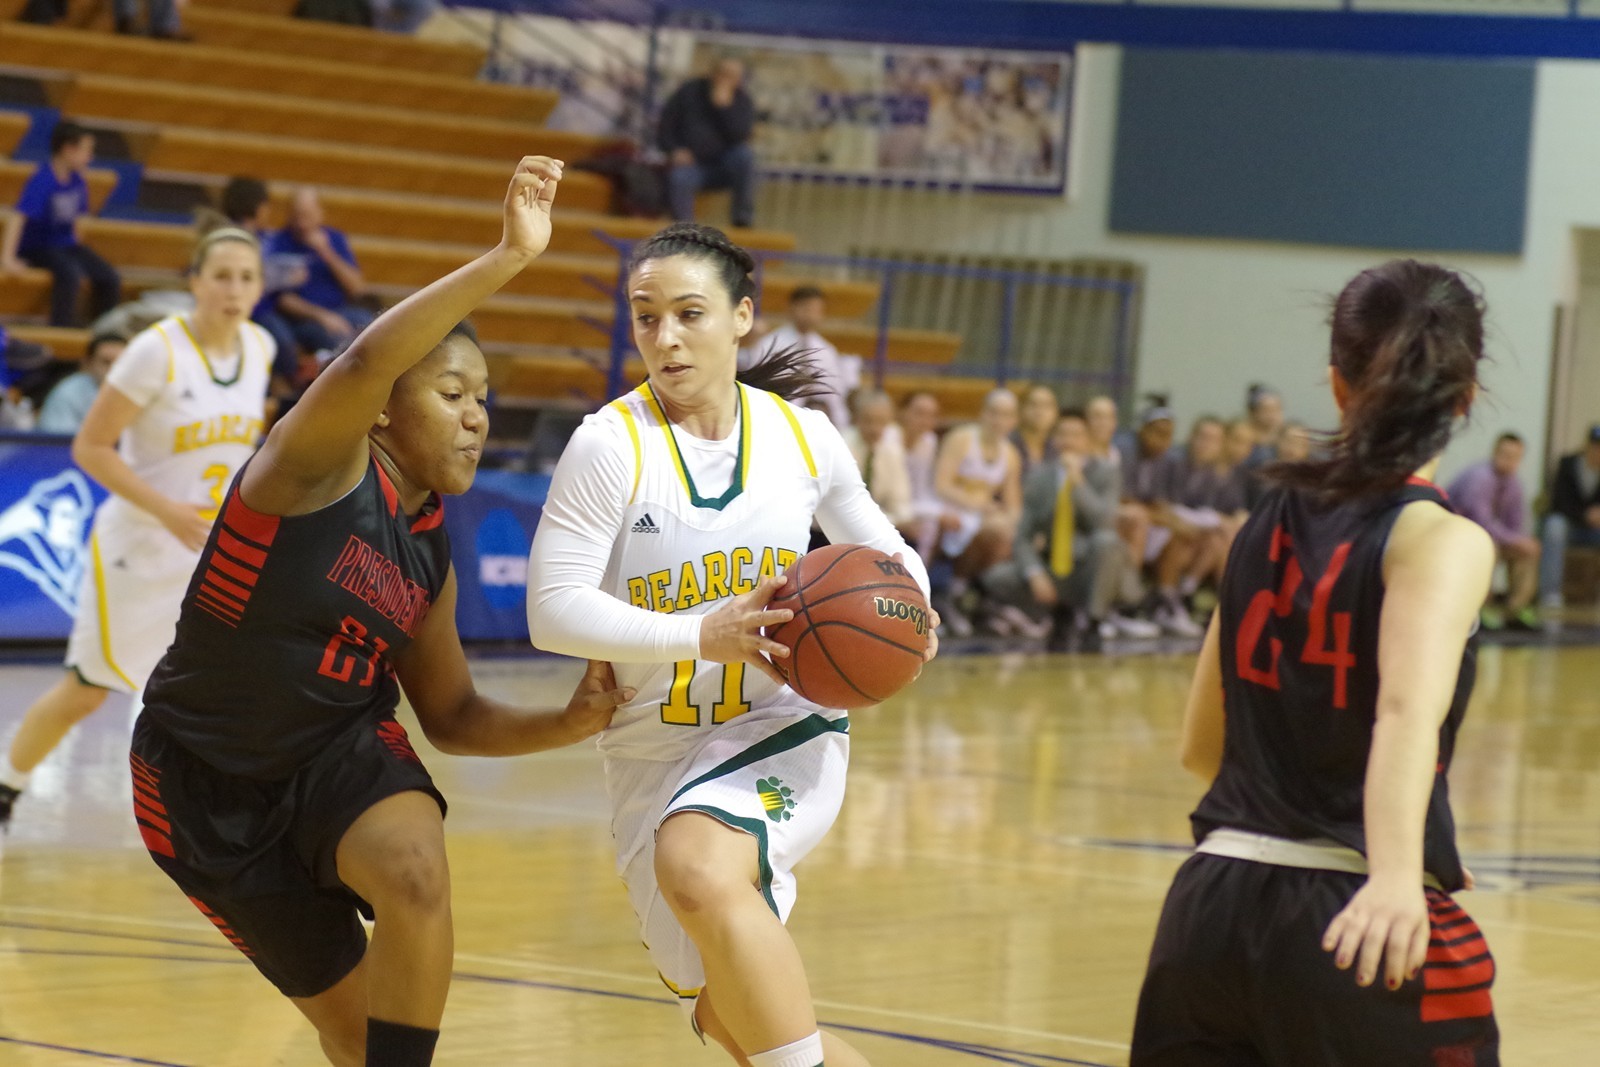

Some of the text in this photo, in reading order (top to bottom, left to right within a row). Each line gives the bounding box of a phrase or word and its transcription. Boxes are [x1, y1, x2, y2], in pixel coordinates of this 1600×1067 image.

[196, 463, 230, 520] 3
[628, 547, 803, 614] BEARCAT
[874, 596, 928, 635] ilson
[1236, 525, 1356, 709] 24
[317, 616, 390, 687] 21
[660, 659, 751, 727] 11
